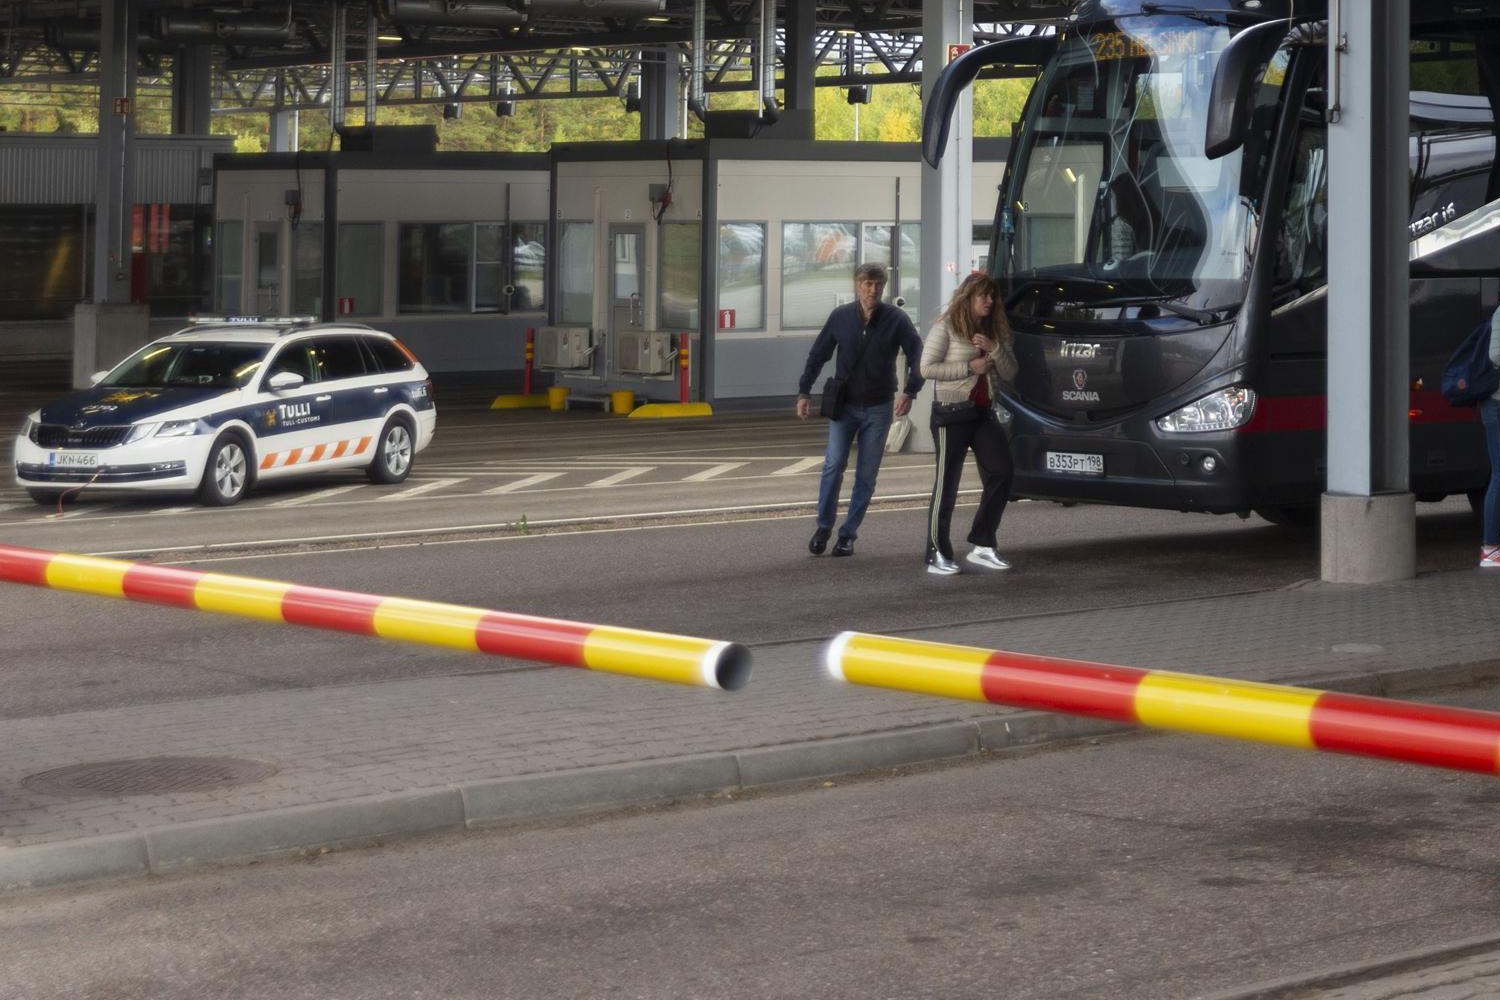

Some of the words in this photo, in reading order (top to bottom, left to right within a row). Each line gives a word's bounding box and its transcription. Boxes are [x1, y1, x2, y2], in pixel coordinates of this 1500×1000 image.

[1094, 31, 1126, 61] 235
[1060, 340, 1100, 359] Irizar
[1062, 391, 1100, 401] SCANIA
[279, 402, 311, 419] TULLI
[56, 455, 96, 465] JKN-466
[1086, 456, 1102, 467] 198
